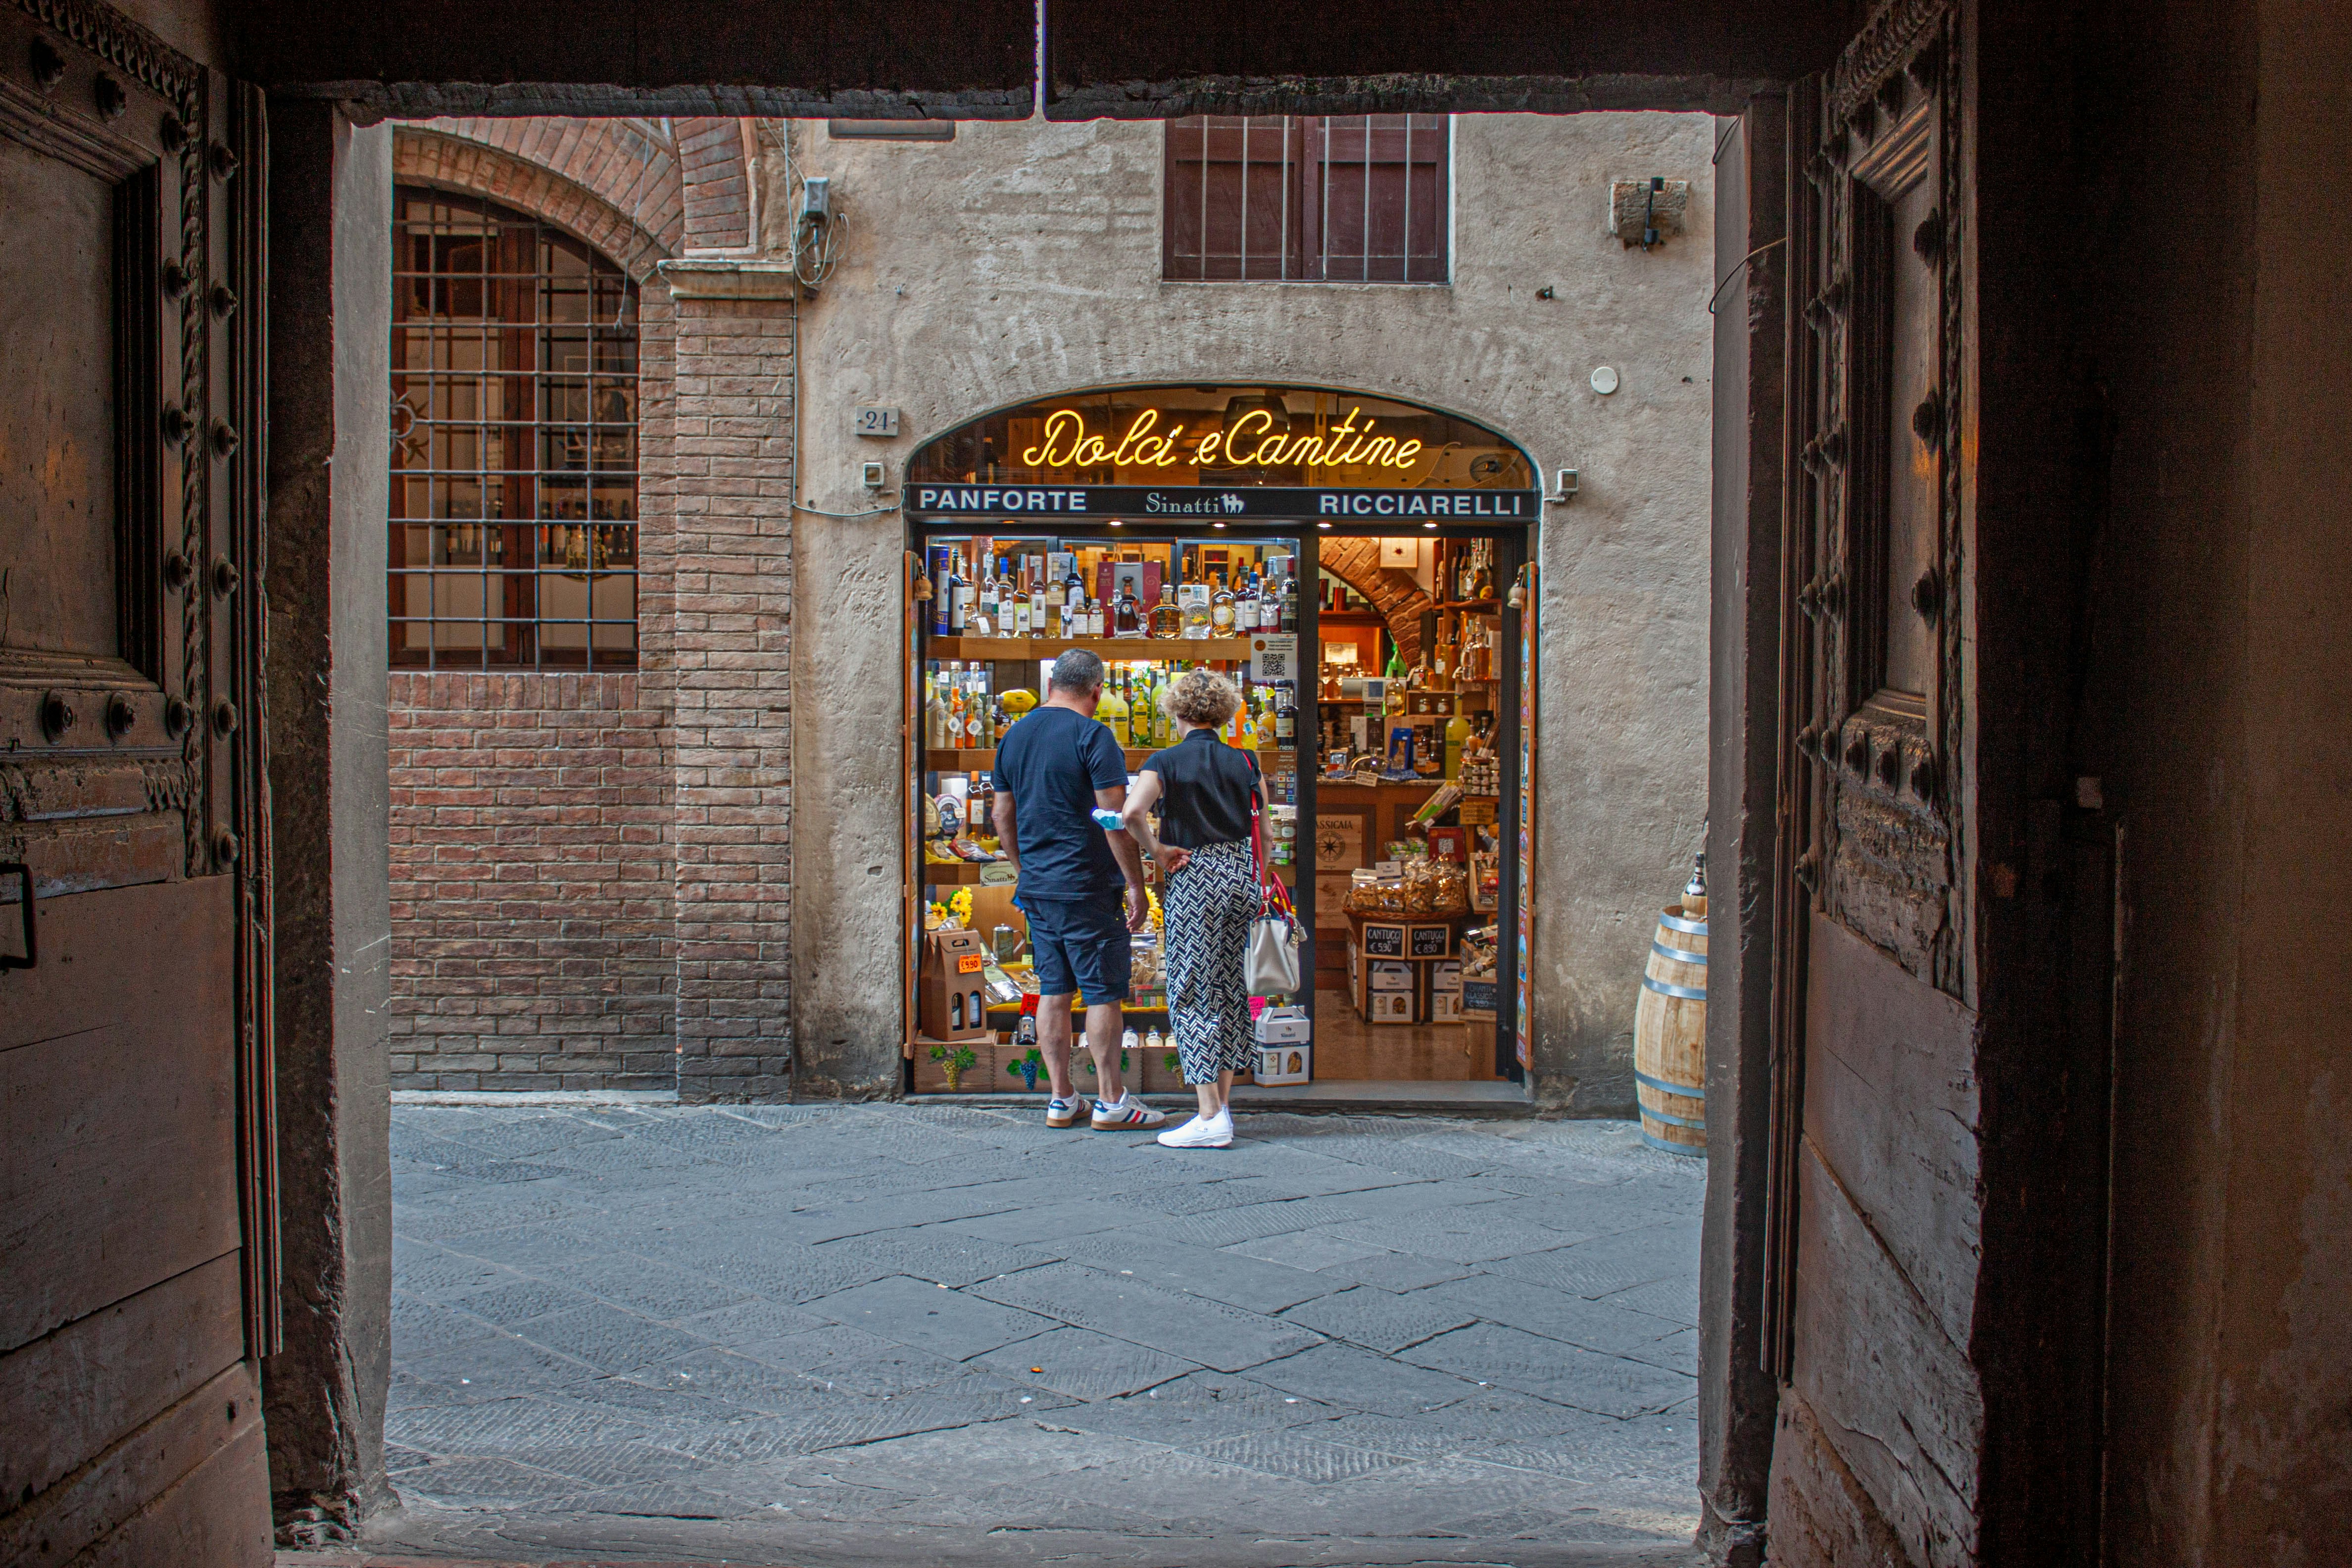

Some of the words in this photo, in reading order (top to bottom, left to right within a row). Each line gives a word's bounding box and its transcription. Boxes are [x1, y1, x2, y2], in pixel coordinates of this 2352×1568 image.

[866, 410, 888, 430] 24
[1023, 408, 1183, 467] Dolci
[1189, 432, 1221, 465] e
[1225, 406, 1421, 469] Cantine
[920, 490, 1086, 511] PANFORTE
[1146, 492, 1220, 513] Sinatti
[1320, 494, 1520, 515] RICCIARELLI
[1368, 929, 1401, 940] CANTUCCI
[1414, 931, 1444, 940] CANTUCCI
